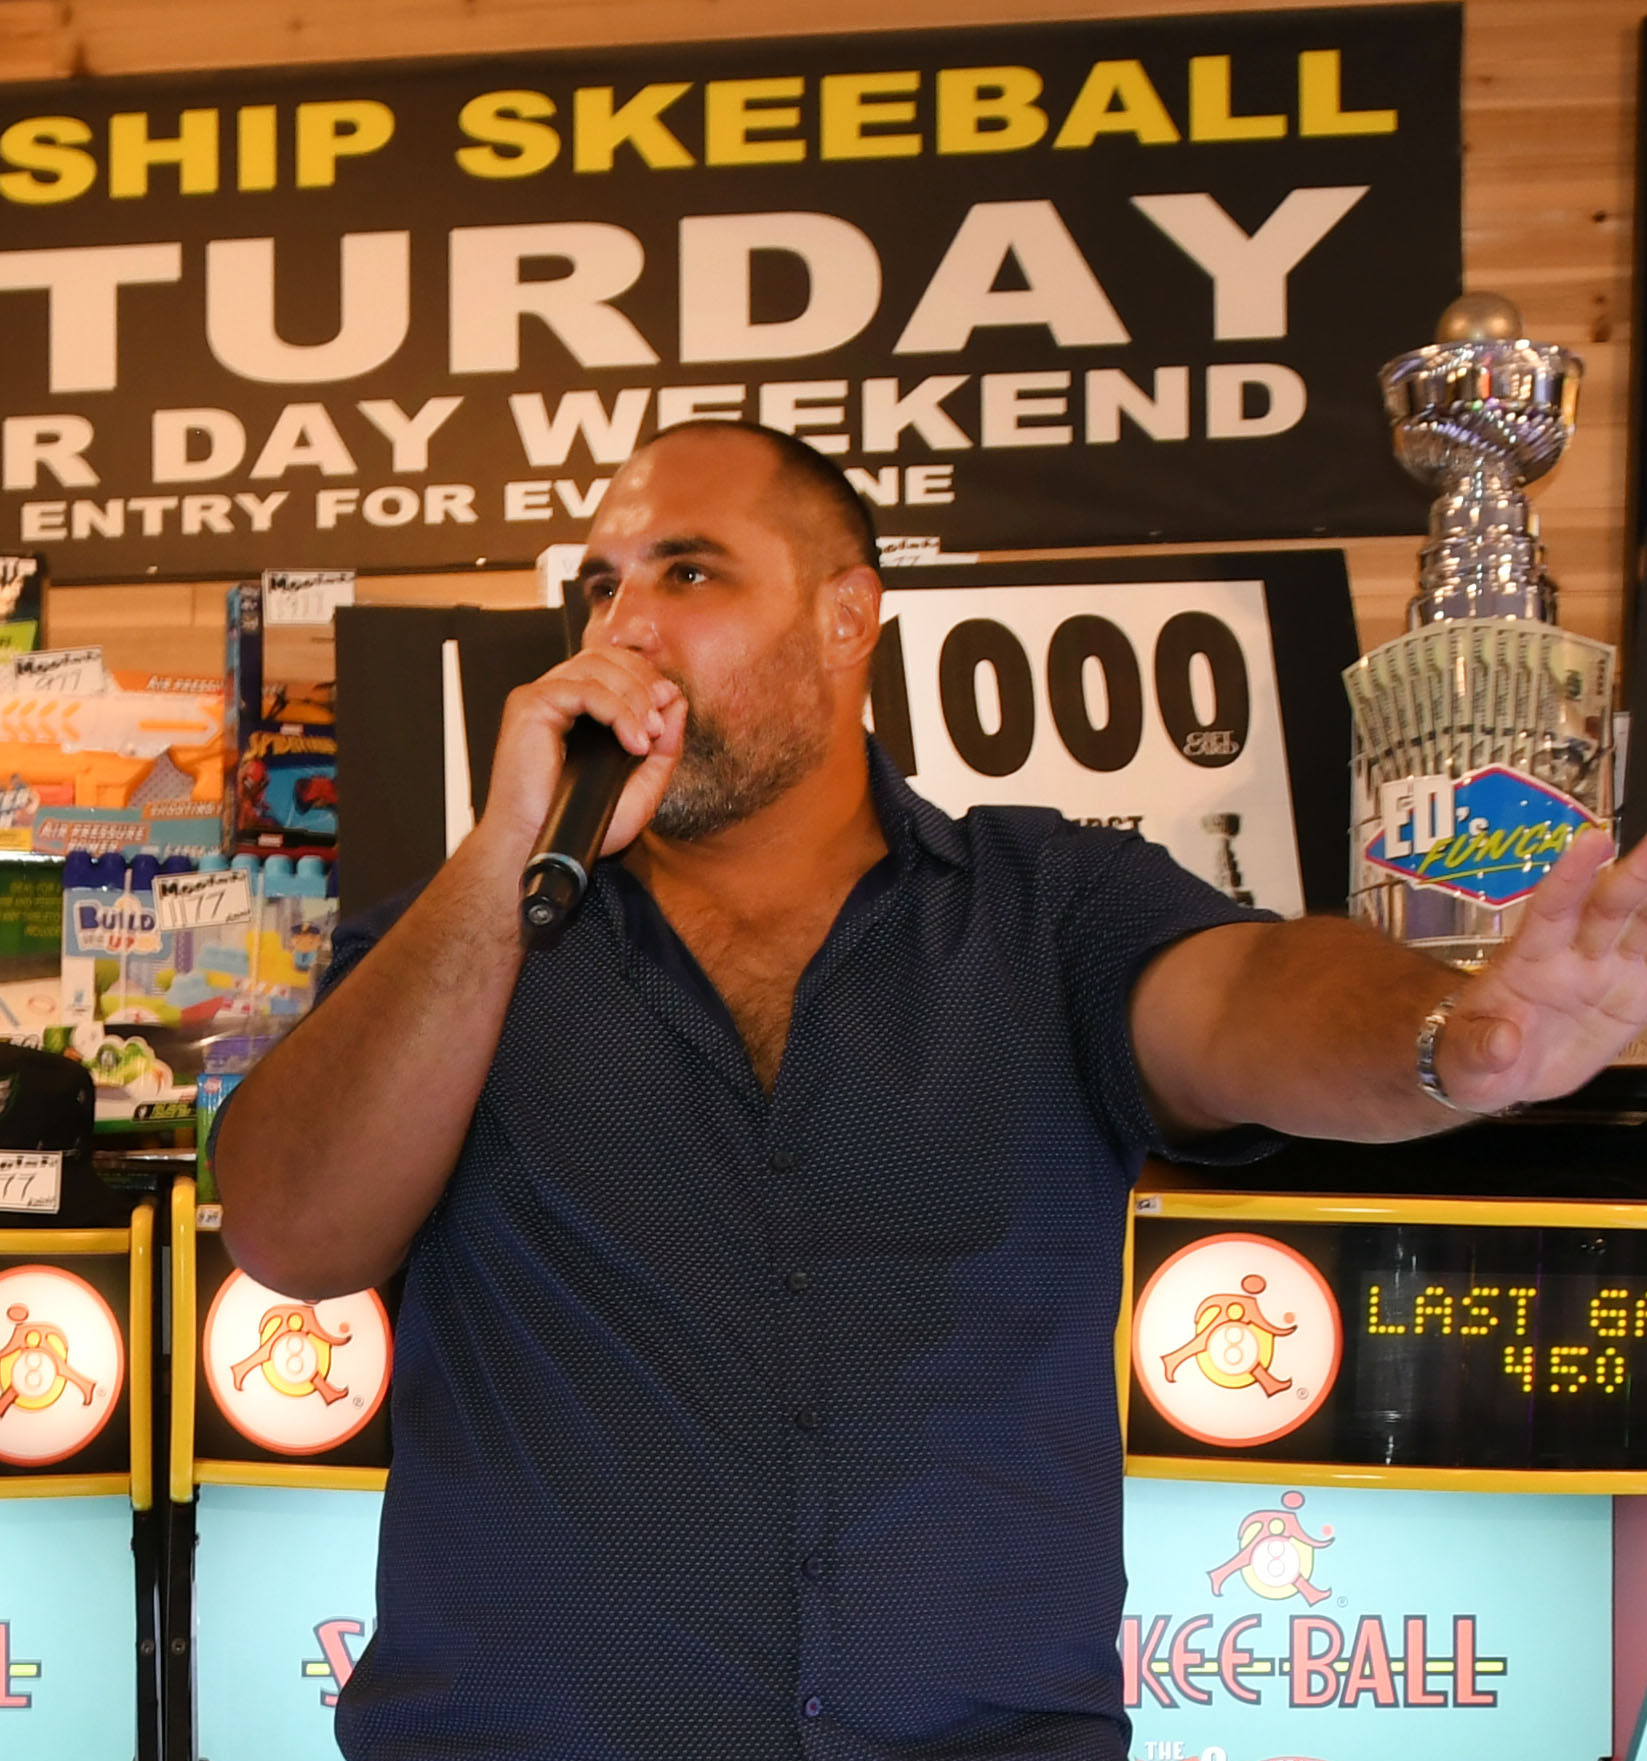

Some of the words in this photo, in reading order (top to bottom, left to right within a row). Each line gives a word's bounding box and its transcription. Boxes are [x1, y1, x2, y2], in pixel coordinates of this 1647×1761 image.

[456, 49, 1399, 180] SKEEBALL
[152, 396, 466, 484] DAY
[25, 493, 290, 541] ENTRY
[317, 486, 476, 529] FOR
[1369, 1286, 1536, 1337] LAST
[1503, 1346, 1626, 1396] 450
[1145, 1741, 1184, 1761] THE
